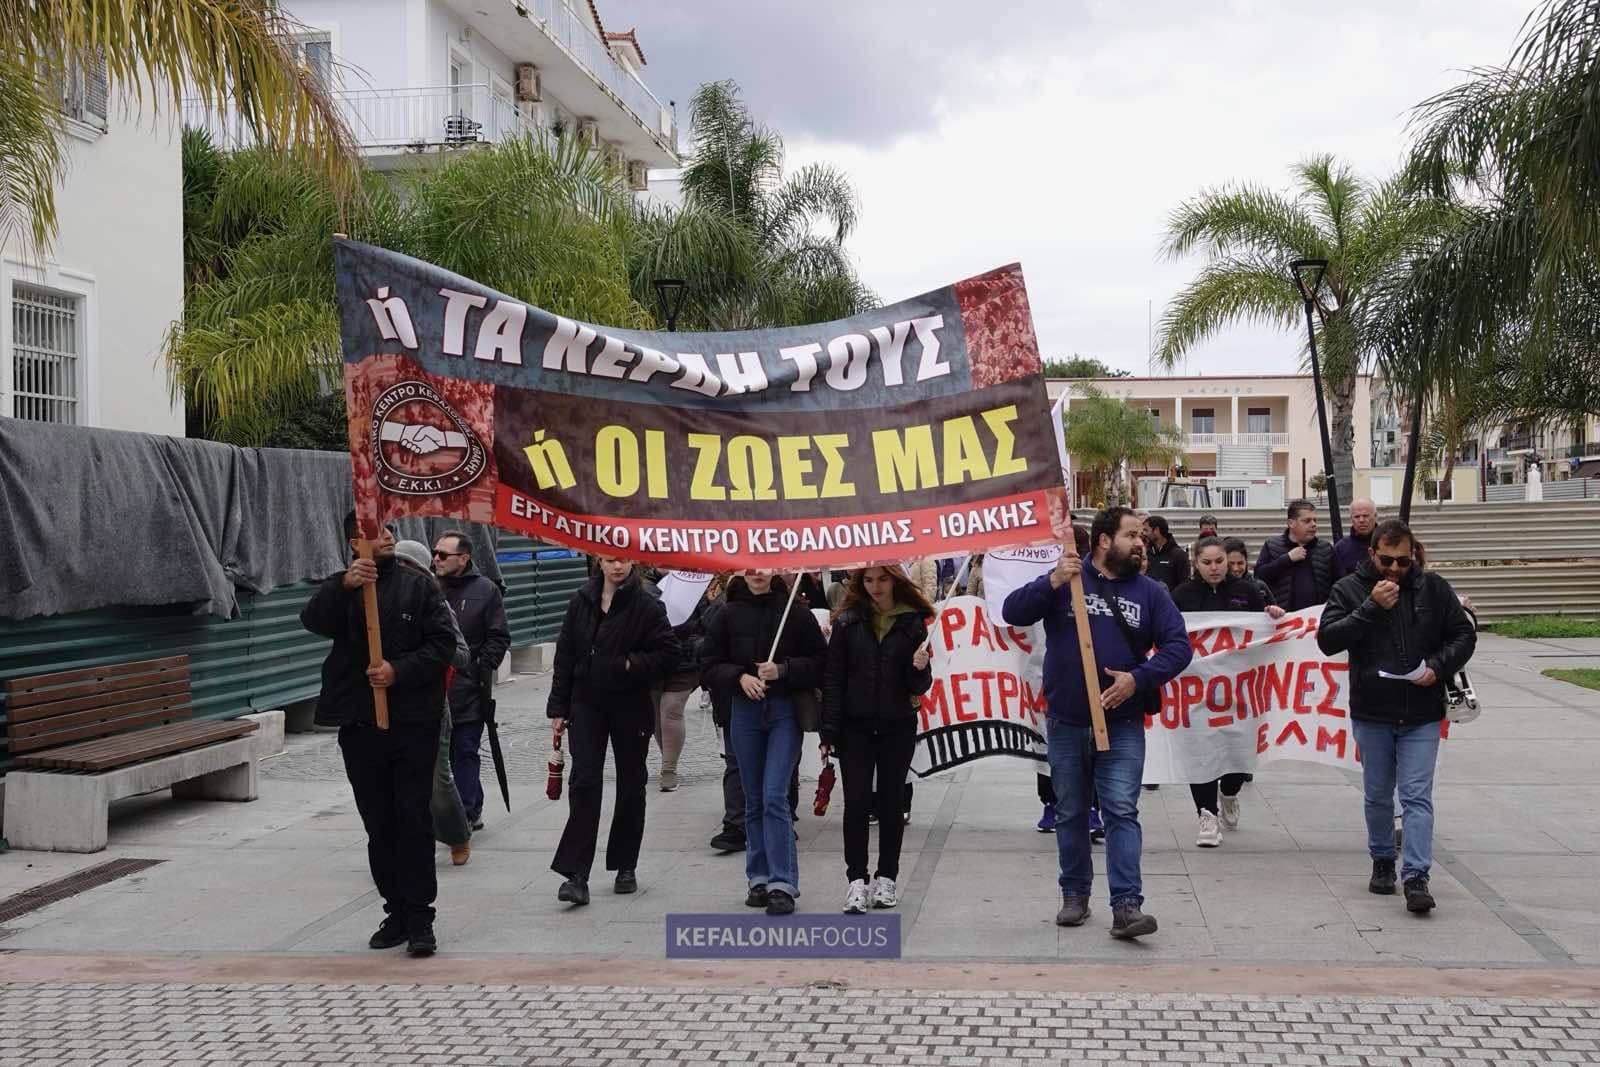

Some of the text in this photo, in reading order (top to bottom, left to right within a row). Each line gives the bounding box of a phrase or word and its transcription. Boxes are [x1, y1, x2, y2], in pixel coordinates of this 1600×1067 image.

[366, 286, 951, 397] ή ΤΑ ΚΕΡΔΗ ΤΟΥΣ
[375, 385, 415, 417] ΚΕΝΤΡΟ
[522, 405, 1028, 500] ή ΟΙ ΖΩΕΣ ΜΑΣ
[510, 494, 630, 549] ΕΡΓΑΤΙΚΟ
[639, 528, 739, 554] ΚΕΝΤΡΟ
[747, 519, 914, 553] ΚΕΦΑΛΟΝΙΑΣ
[940, 501, 1038, 538] ΙΘΑΚΗΣ
